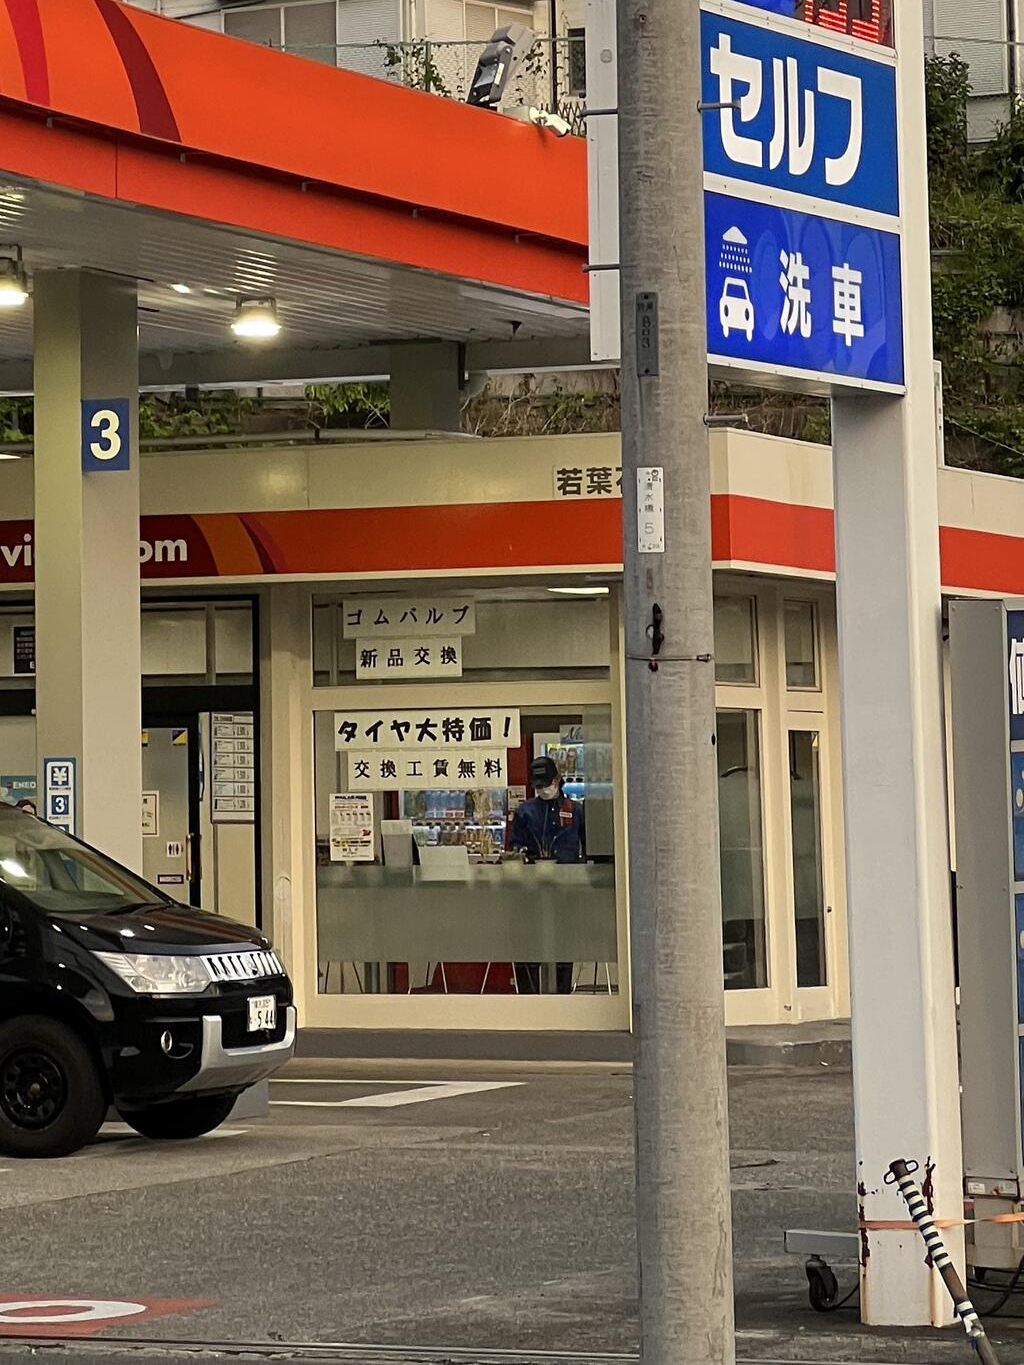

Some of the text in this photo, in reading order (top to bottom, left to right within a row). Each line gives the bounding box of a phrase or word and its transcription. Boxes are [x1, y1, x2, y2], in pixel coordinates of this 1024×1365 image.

[710, 33, 863, 186] セルフ
[779, 248, 864, 346] 洗車
[90, 409, 121, 460] 3
[347, 605, 469, 626] ゴムバルブ
[361, 646, 457, 668] 新品交換
[354, 758, 502, 779] 交換工賃無料
[56, 797, 65, 813] 3
